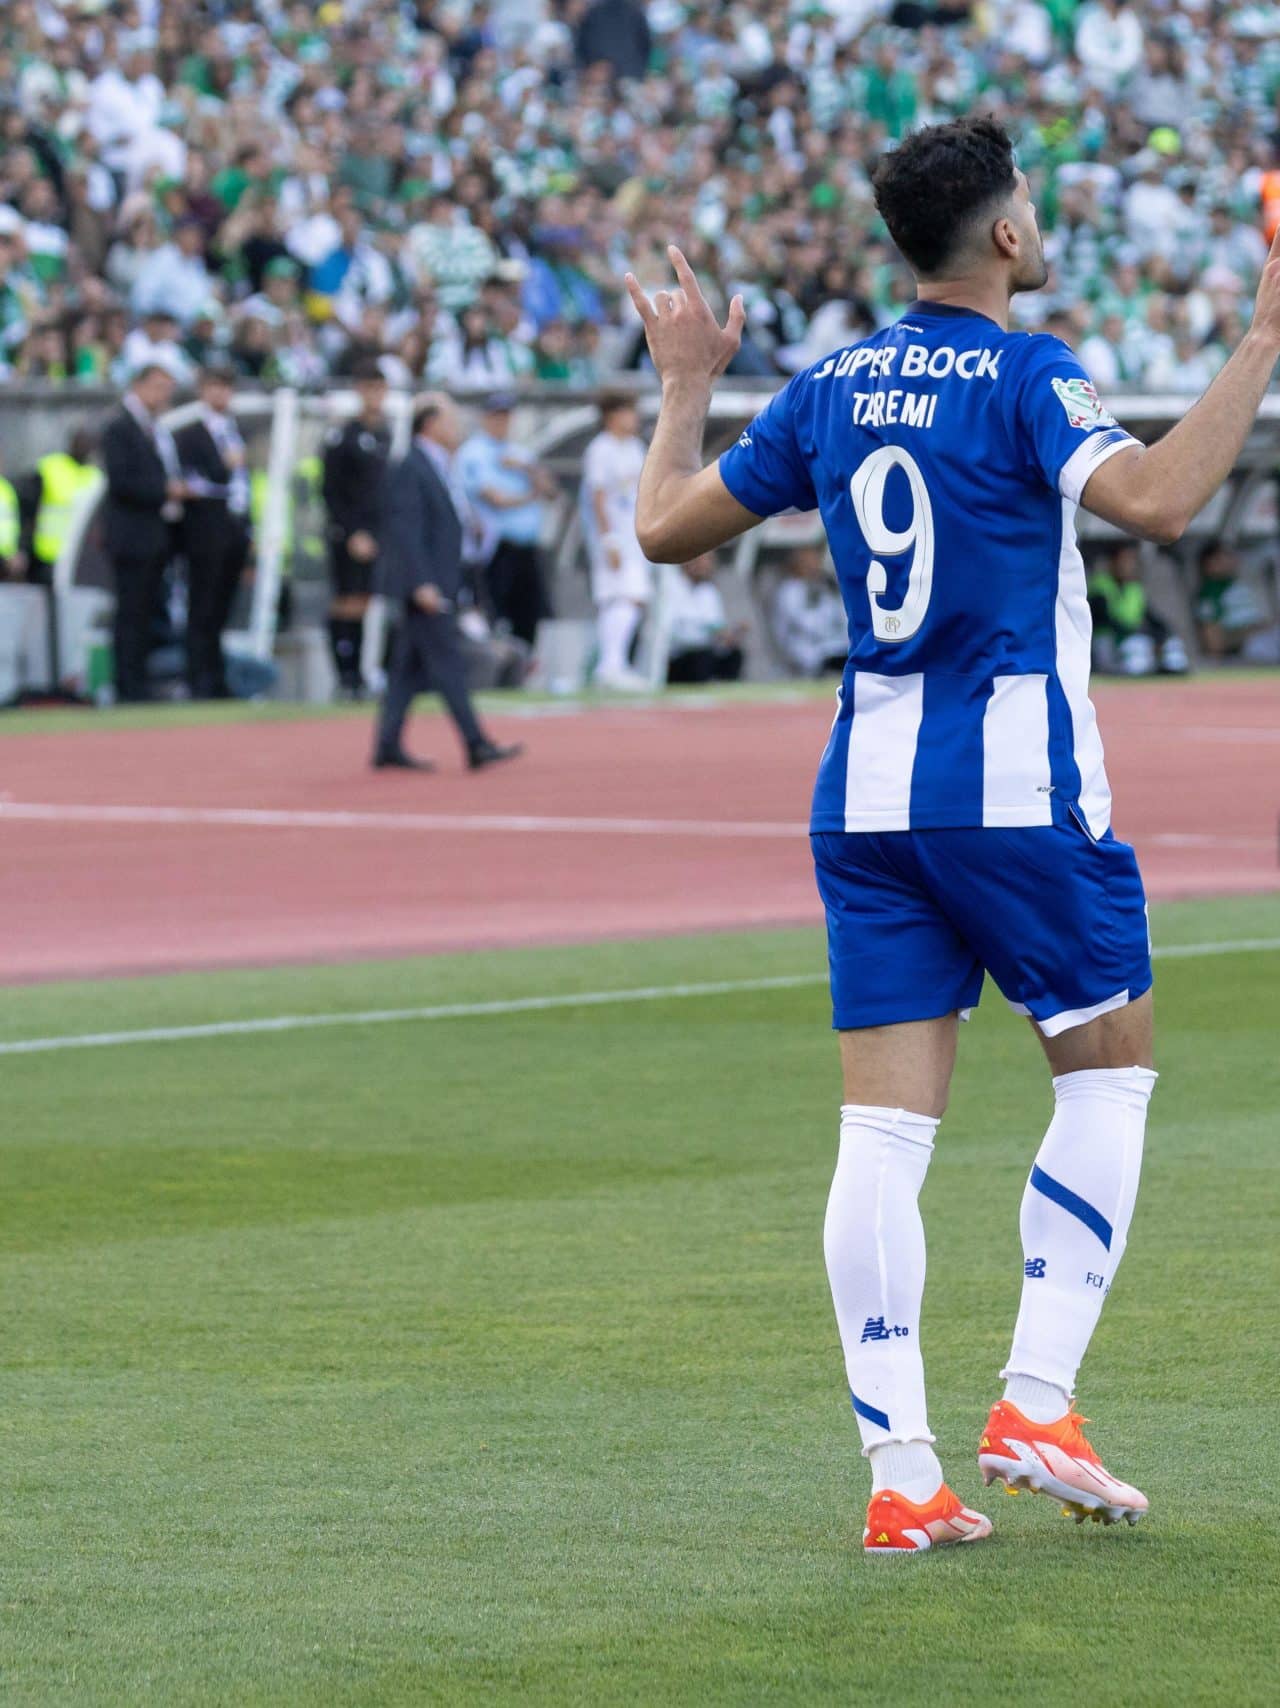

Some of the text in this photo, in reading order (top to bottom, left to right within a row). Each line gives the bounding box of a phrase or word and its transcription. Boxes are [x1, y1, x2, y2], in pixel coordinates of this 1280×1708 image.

[900, 345, 1004, 380] BOCK
[853, 390, 937, 428] TAREMI
[850, 445, 935, 643] 9
